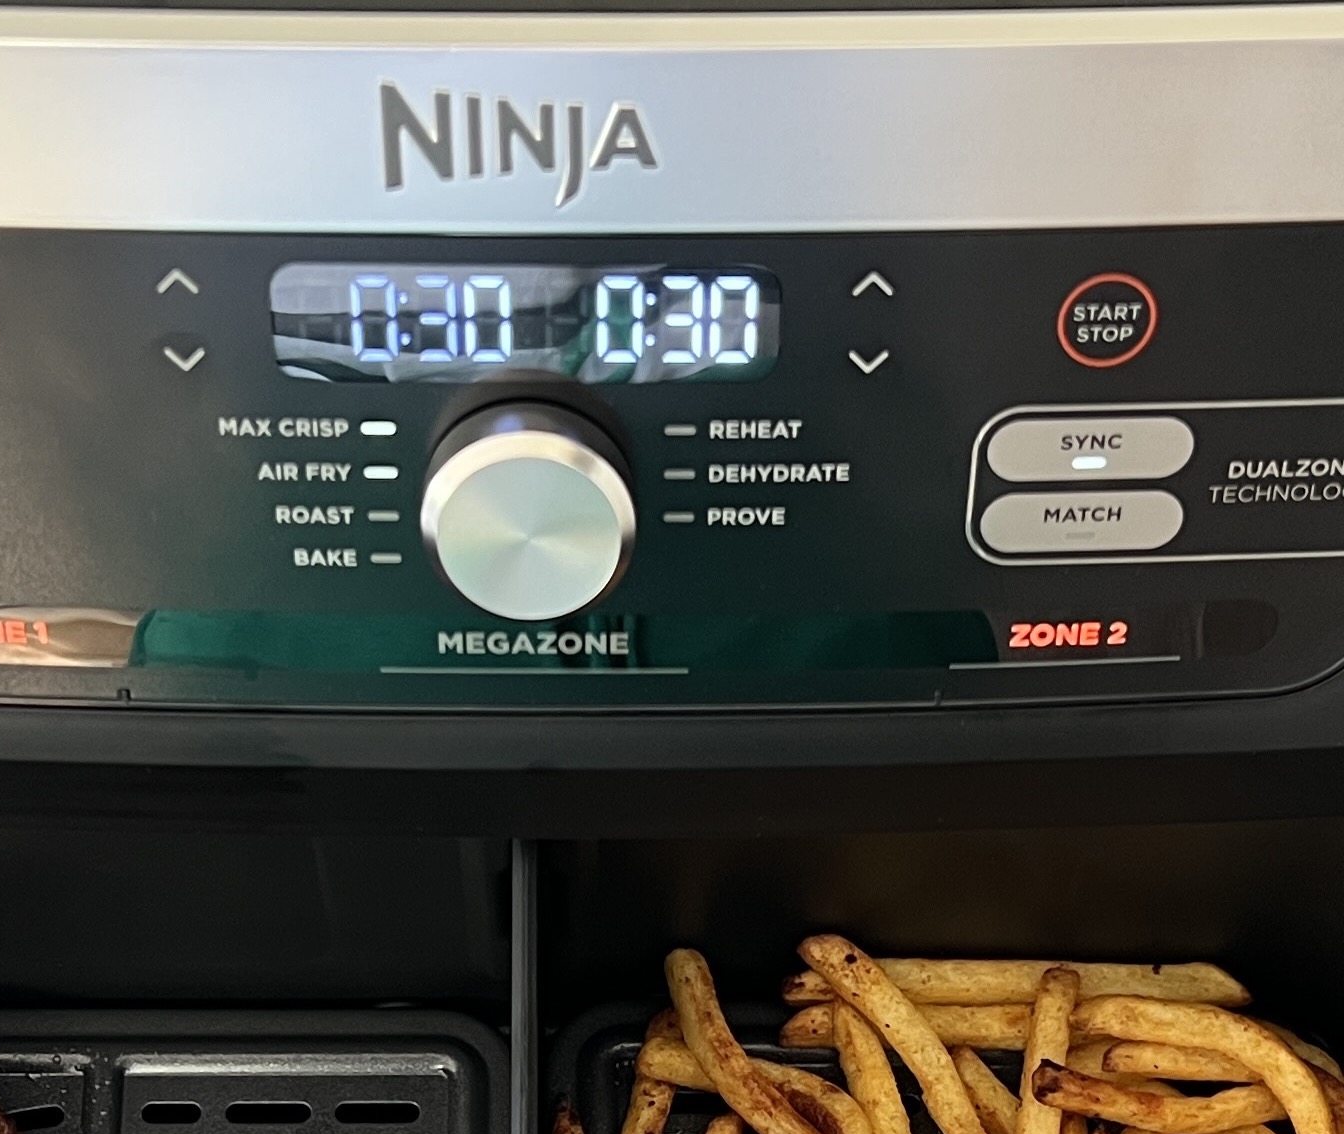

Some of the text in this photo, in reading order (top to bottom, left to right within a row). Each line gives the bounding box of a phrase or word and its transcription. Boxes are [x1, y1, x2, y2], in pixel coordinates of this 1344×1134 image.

[350, 275, 512, 363] 0:30
[596, 275, 759, 364] 0:30
[1072, 303, 1142, 323] START
[1076, 326, 1134, 343] STOP
[218, 417, 349, 438] MAX CRISP
[709, 419, 802, 440] REHEAT
[1060, 434, 1123, 451] SYNC
[258, 461, 352, 482] AIR FRY
[708, 462, 850, 484] DEHYDRATE
[275, 505, 355, 525] ROAST
[707, 506, 786, 526] PROVE
[1043, 506, 1123, 524] MATCH
[293, 548, 358, 568] BAKE
[33, 619, 48, 644] 1
[1009, 621, 1129, 648] ZONE 2
[436, 631, 631, 656] MEGAZONE
